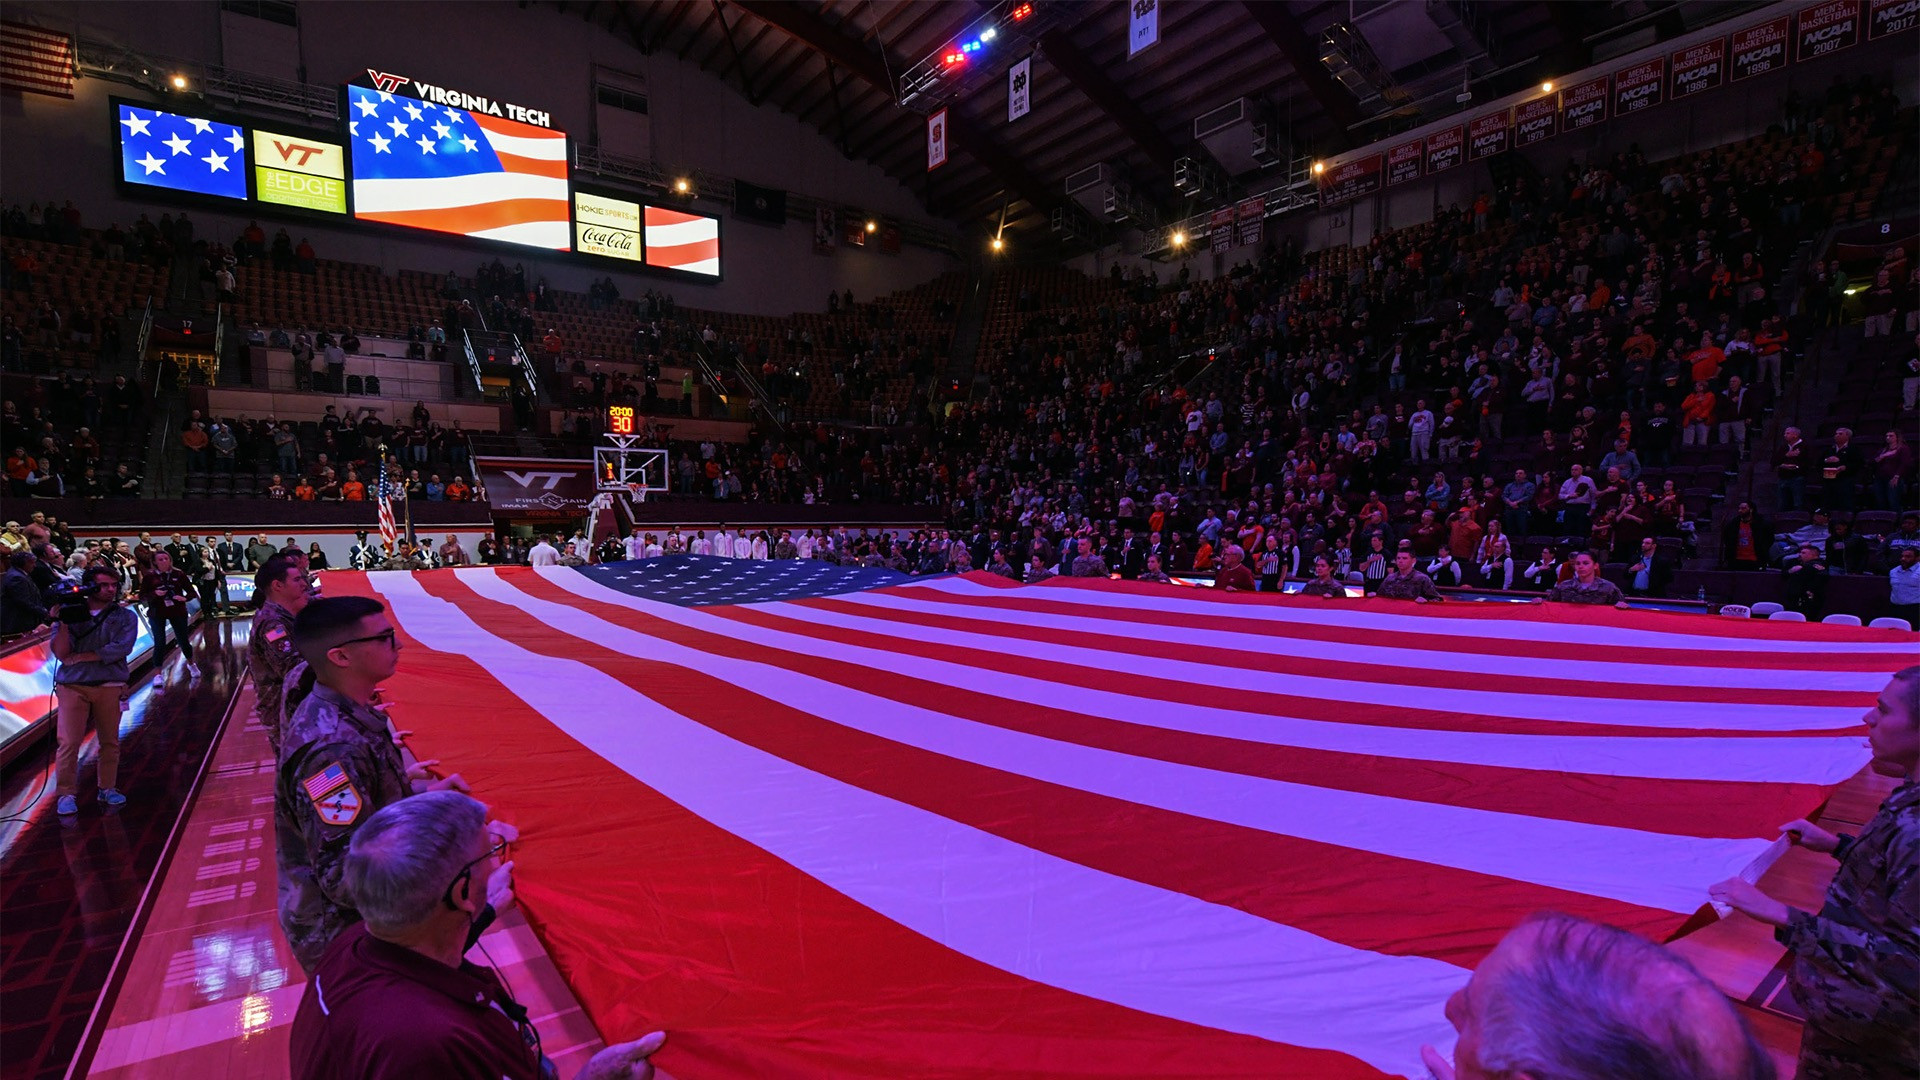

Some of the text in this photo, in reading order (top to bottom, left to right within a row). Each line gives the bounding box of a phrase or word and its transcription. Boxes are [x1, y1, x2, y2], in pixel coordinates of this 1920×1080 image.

[1801, 6, 1857, 31] BASKETBALL
[1814, 1, 1845, 19] MEN'S
[1747, 25, 1775, 41] MEN'S
[1804, 20, 1852, 45] NCAA
[1886, 15, 1916, 33] 2017
[1735, 29, 1786, 53] BASKETBALL
[1813, 38, 1841, 55] 2007
[1674, 50, 1722, 72] BASKETBALL
[1685, 45, 1711, 60] MEN'S
[1737, 43, 1781, 67] NCAA
[1677, 63, 1718, 85] NCAA
[1746, 60, 1770, 76] 1996
[1618, 70, 1662, 90] BASKETBALL
[1686, 79, 1707, 93] 1986
[367, 69, 550, 128] VT VIRGINIA TECH
[1565, 87, 1606, 106] BASKETBALL
[1620, 82, 1658, 103] NCAA
[1568, 99, 1602, 118] NCAA
[1520, 115, 1552, 134] NCAA
[1474, 131, 1504, 149] NCAA
[273, 140, 324, 166] VT
[1430, 145, 1459, 162] NCAA
[275, 173, 338, 198] EDGE
[1881, 223, 1890, 233] 8
[587, 245, 606, 253] zero
[182, 320, 192, 328] 17
[609, 406, 634, 417] 20:00
[612, 416, 632, 432] 30
[502, 470, 577, 490] VT
